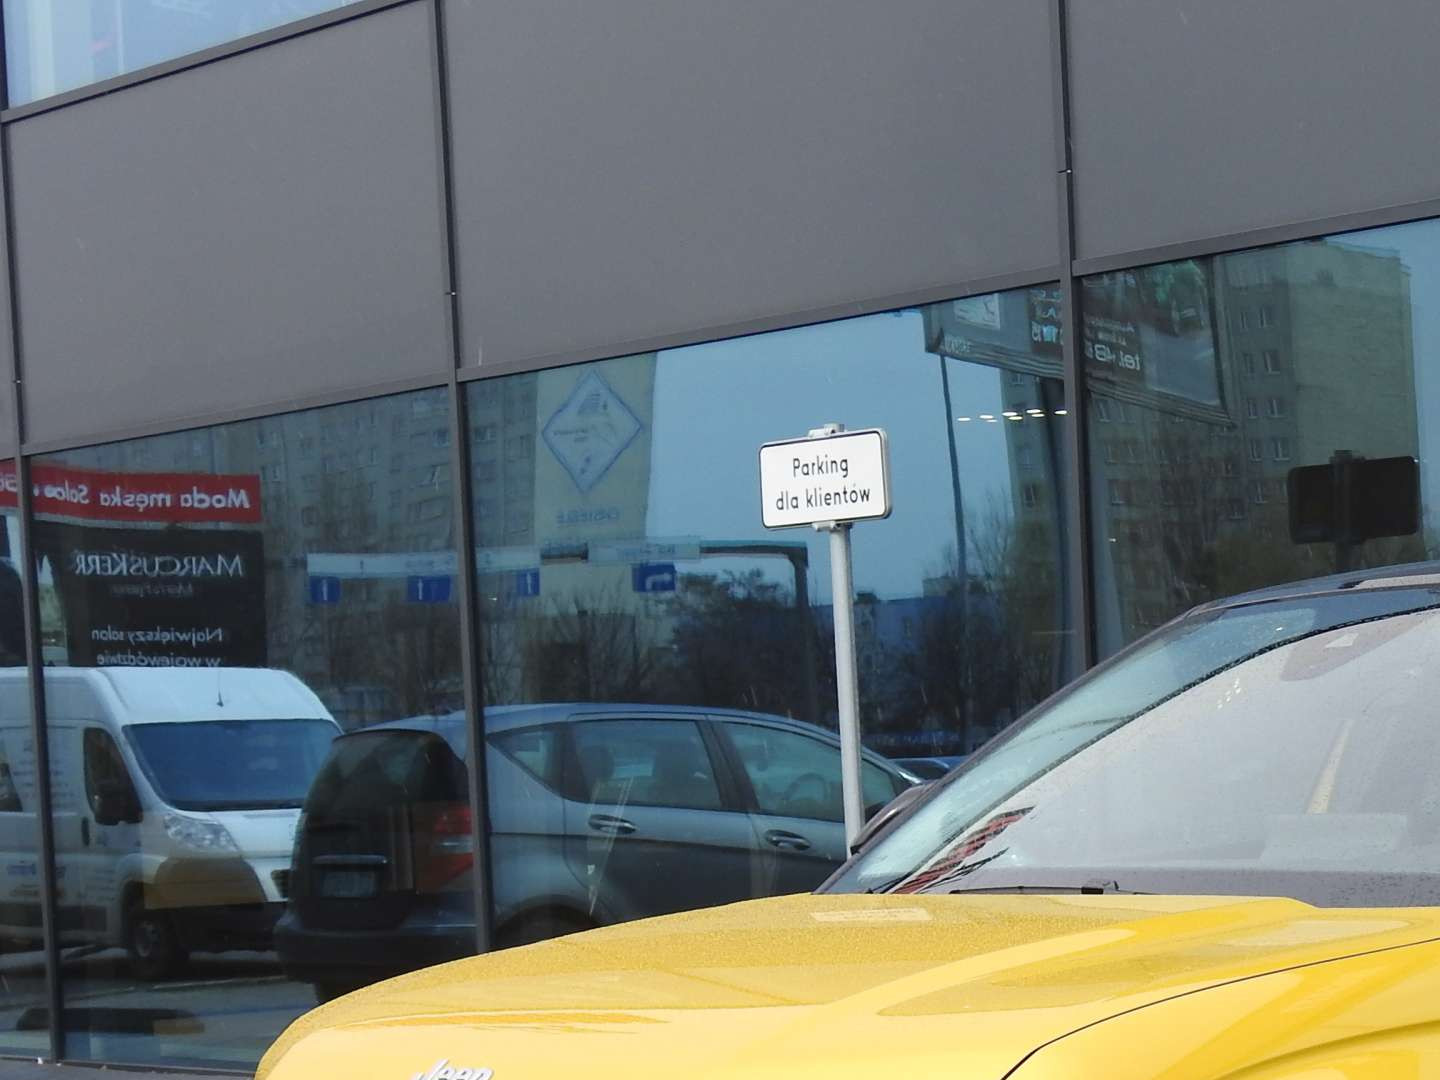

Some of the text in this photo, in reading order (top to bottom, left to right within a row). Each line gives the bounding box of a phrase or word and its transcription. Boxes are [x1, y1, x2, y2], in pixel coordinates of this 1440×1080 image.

[792, 454, 849, 478] Parking
[776, 483, 871, 511] dla klientów
